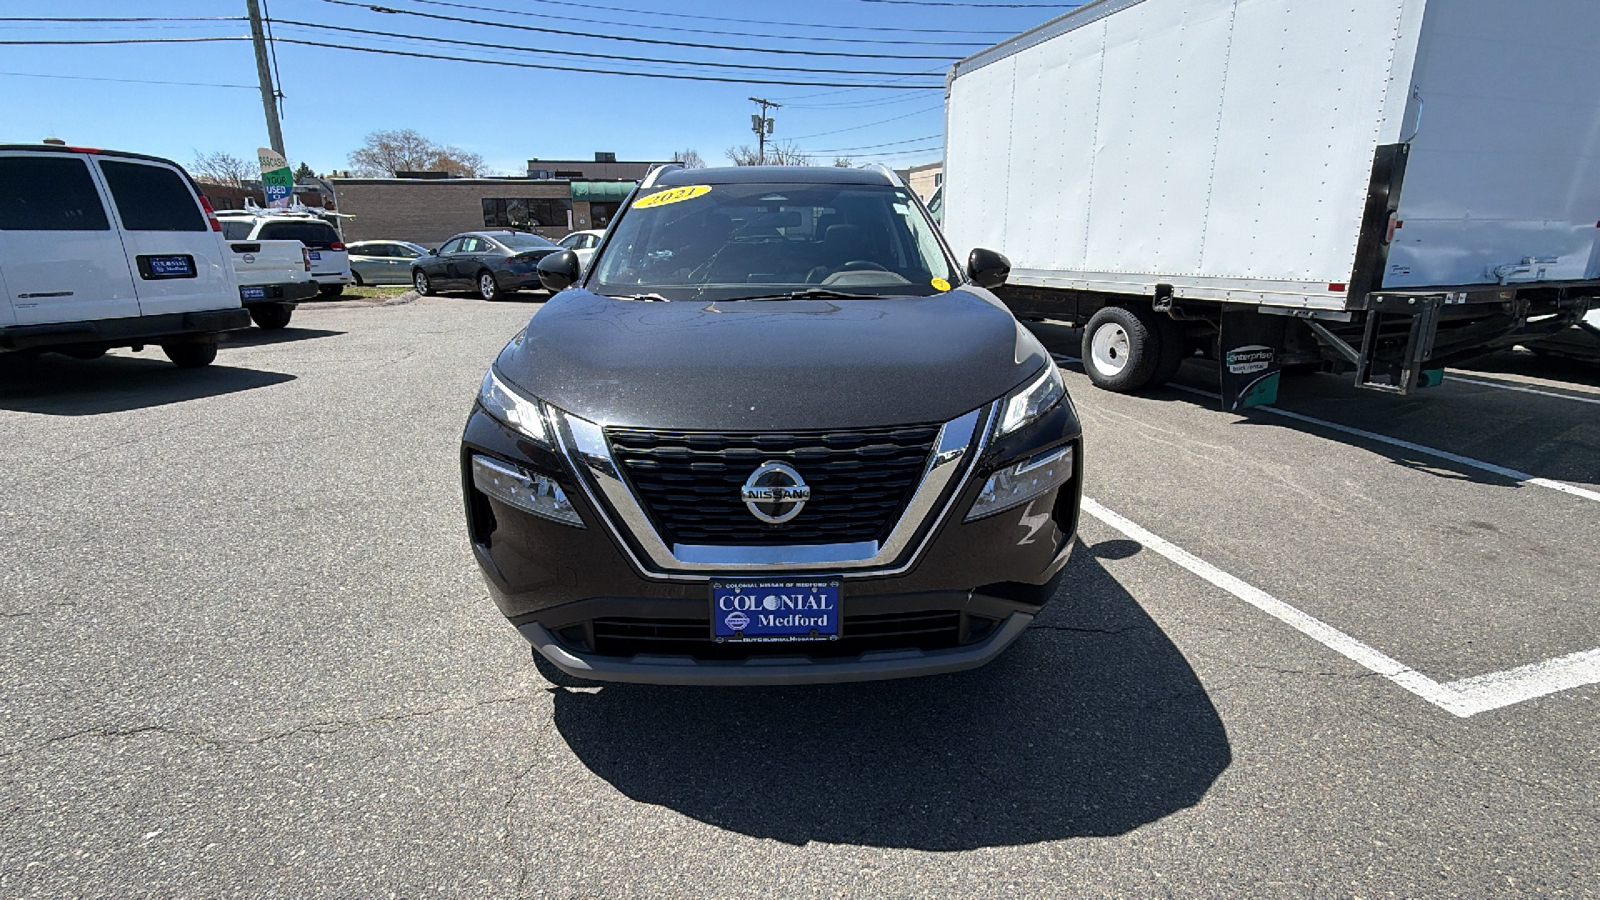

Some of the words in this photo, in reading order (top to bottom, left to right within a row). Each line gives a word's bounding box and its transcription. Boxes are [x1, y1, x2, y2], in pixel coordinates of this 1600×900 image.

[267, 176, 287, 185] YOUR
[267, 185, 286, 194] USED
[648, 187, 696, 206] 2021
[1229, 351, 1273, 362] enterprise
[748, 490, 803, 499] NISSAN
[719, 594, 834, 611] COLONIAL
[758, 614, 828, 627] Medford
